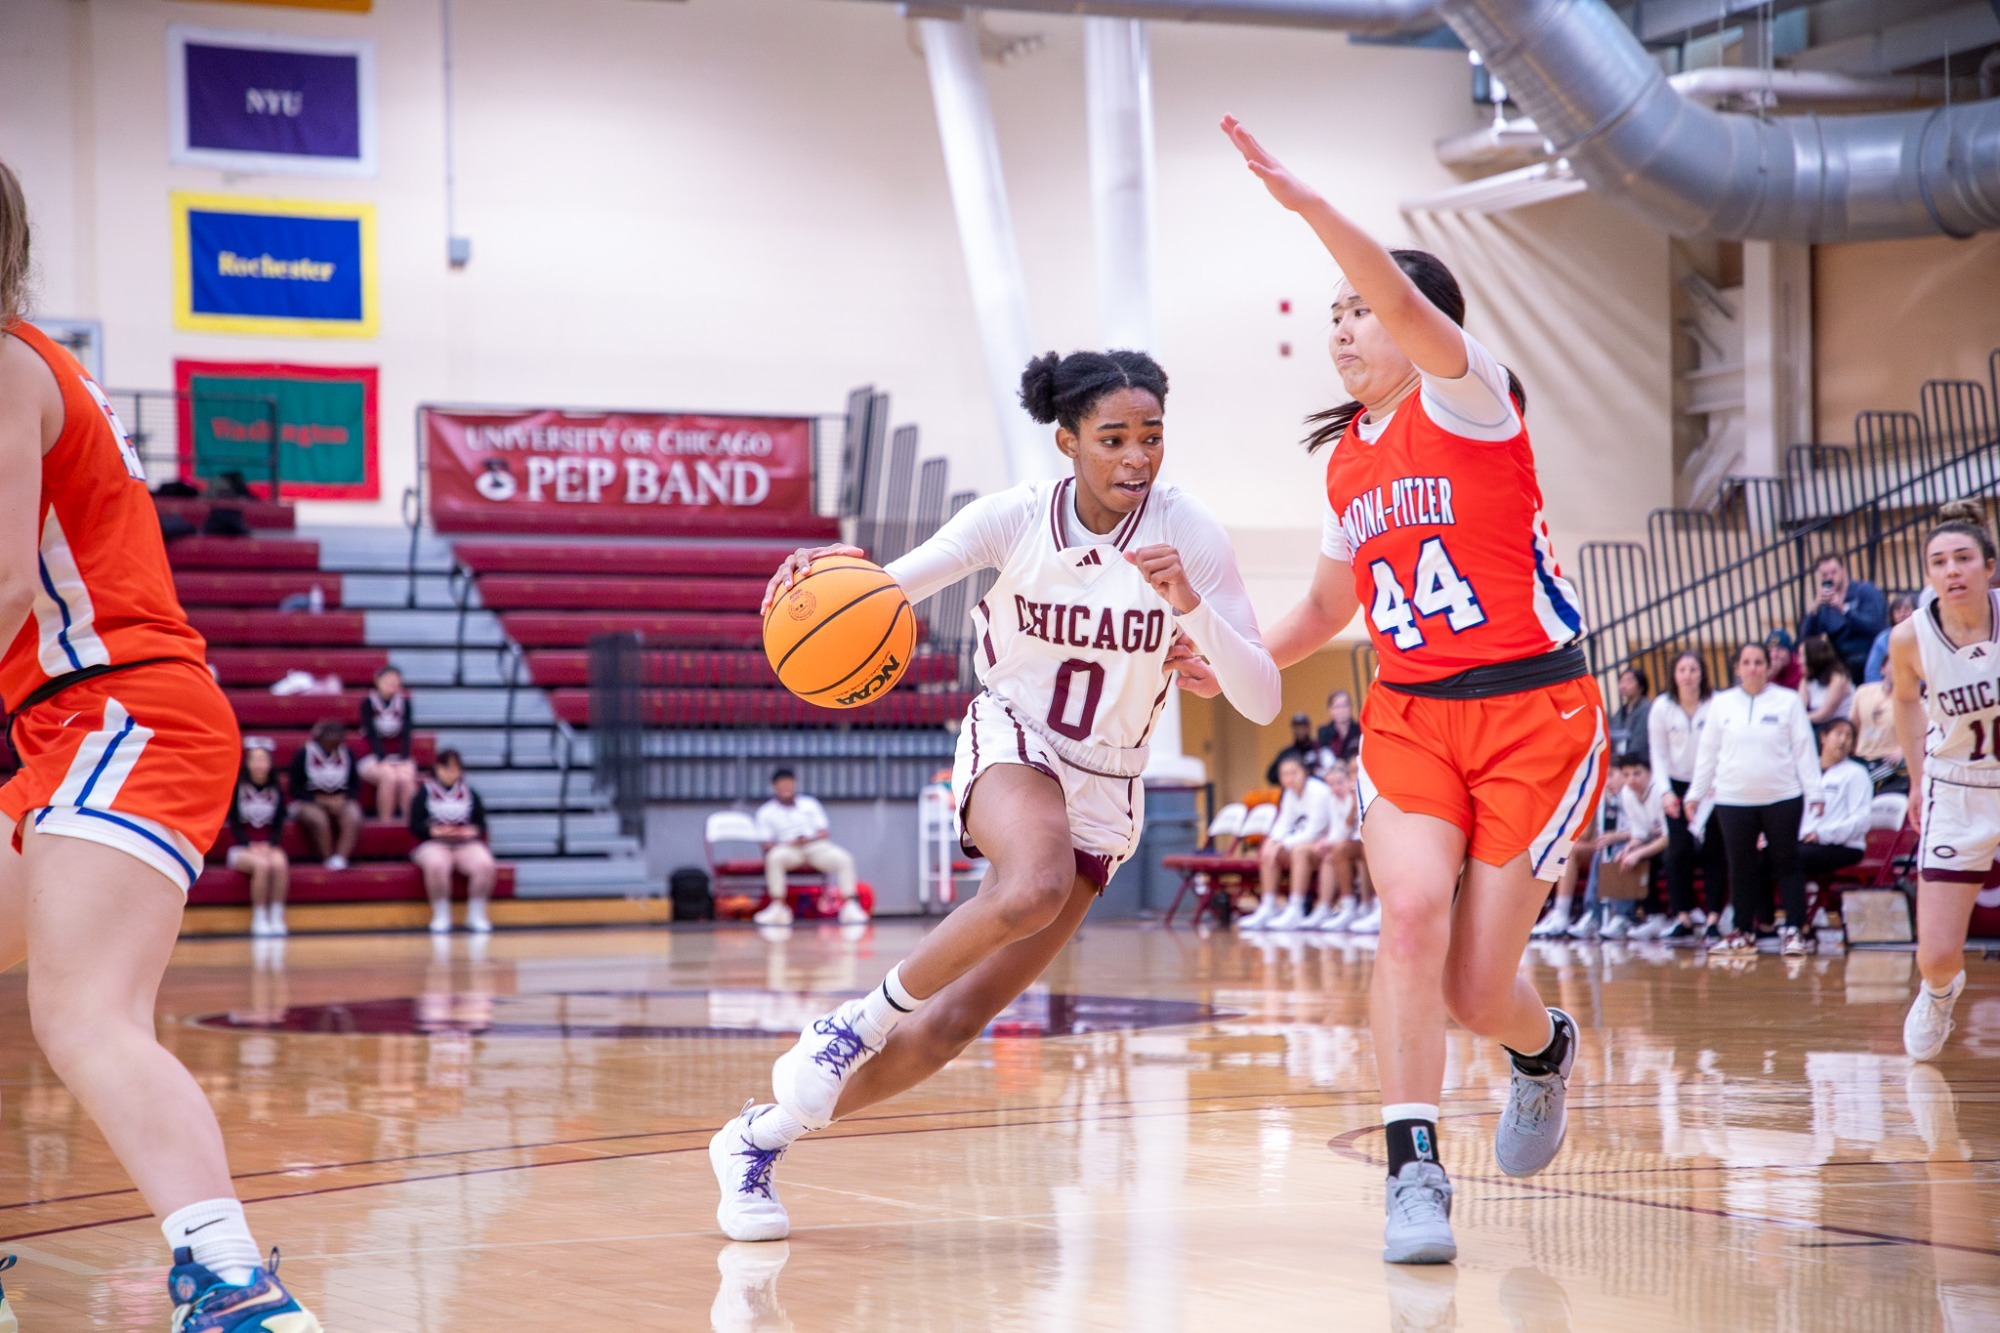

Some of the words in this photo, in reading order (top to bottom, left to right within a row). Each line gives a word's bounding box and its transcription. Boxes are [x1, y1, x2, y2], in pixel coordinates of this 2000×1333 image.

[246, 87, 302, 118] NYU
[217, 250, 335, 281] Rochester
[210, 417, 349, 448] Washngton
[464, 425, 617, 454] UNIVERSITY
[620, 428, 651, 455] OF
[657, 430, 773, 457] CHICAGO
[525, 456, 617, 502] PEP
[624, 459, 771, 506] BAND
[1368, 534, 1488, 652] 44
[1014, 594, 1165, 654] CHICAGO
[835, 654, 900, 705] NCAA
[1046, 658, 1105, 742] 0
